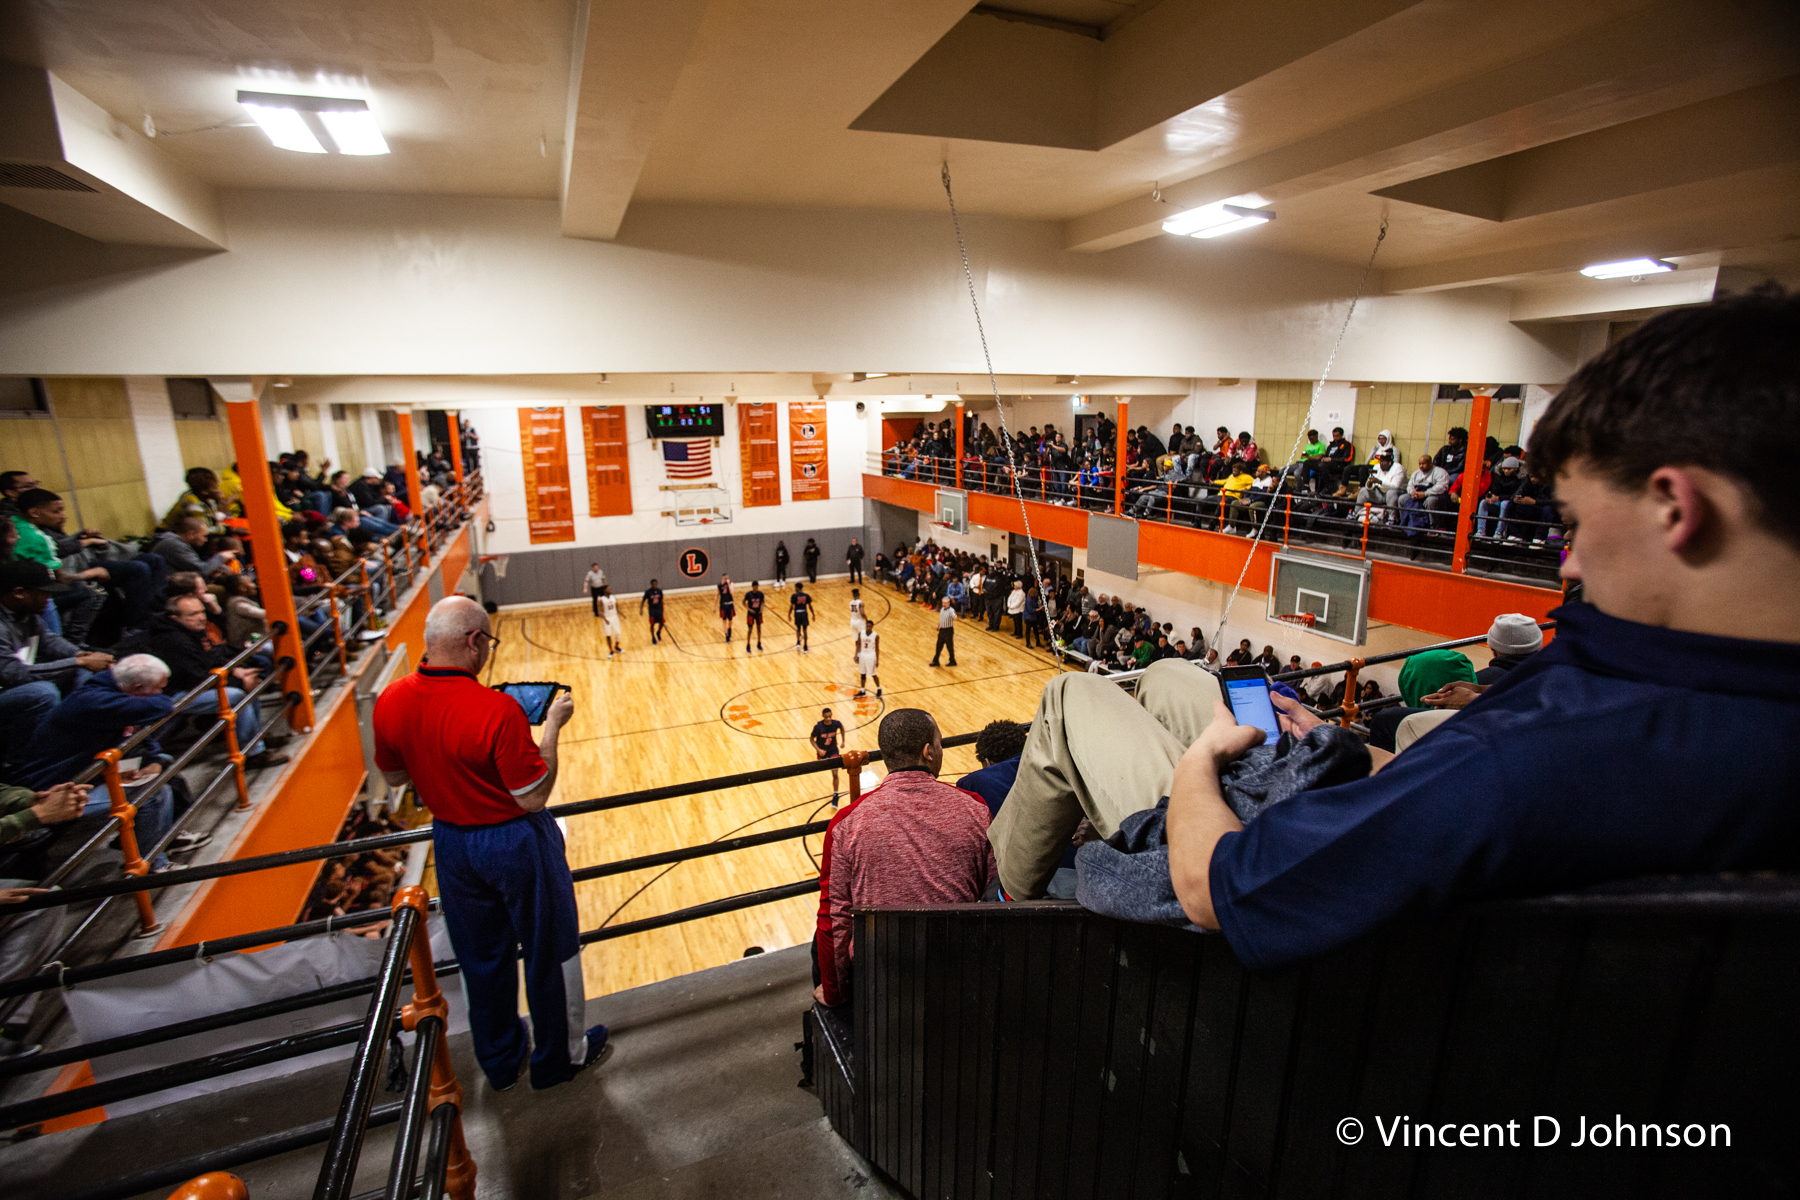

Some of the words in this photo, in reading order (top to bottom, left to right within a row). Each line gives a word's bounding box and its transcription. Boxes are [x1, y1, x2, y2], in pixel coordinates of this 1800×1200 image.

[661, 406, 672, 415] 38
[699, 405, 711, 415] 51
[583, 423, 595, 459] FIELD
[520, 425, 540, 521] BASKETBALL
[740, 437, 753, 507] FOOTBALL
[588, 474, 600, 515] TRACK
[686, 553, 702, 573] L
